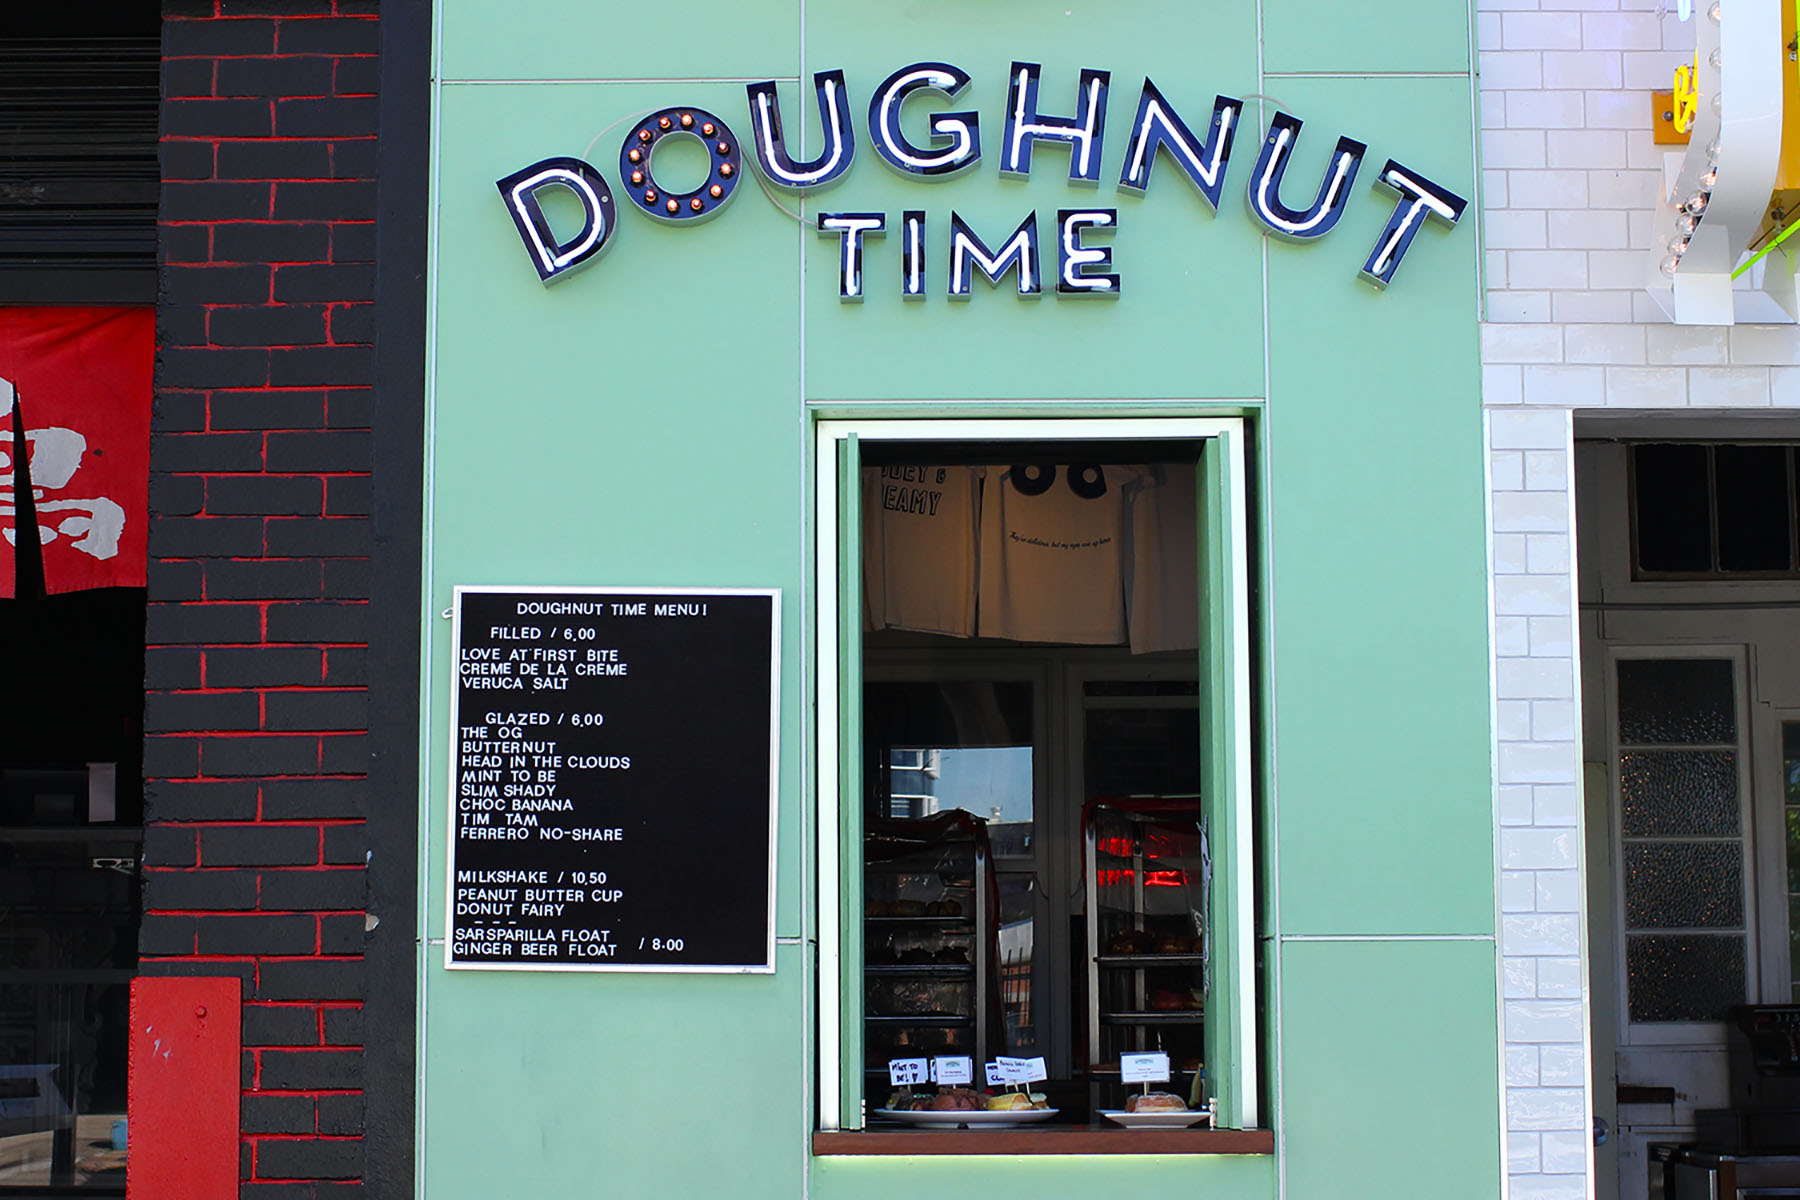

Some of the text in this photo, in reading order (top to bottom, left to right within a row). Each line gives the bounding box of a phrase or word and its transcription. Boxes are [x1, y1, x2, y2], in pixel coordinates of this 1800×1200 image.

[496, 61, 1468, 290] DOUGHNUT
[817, 208, 1120, 303] TIME
[882, 485, 943, 516] EAMY
[516, 602, 604, 616] DOUGHNUT
[610, 603, 647, 616] TIME
[490, 626, 542, 640] FILLED
[550, 627, 557, 639] /
[461, 647, 619, 663] LOVE AT FIRST BITE
[460, 662, 628, 676] CREME DE LA CREME
[462, 676, 569, 690] VERUCA SALT
[485, 711, 550, 726] GLAZED
[557, 712, 565, 725] /
[460, 726, 523, 739] THE OG
[462, 740, 557, 755] BUTTERNUT
[461, 754, 631, 770] HEAD IN THE CLOUDS
[461, 769, 556, 783] MINT TO BE
[460, 783, 557, 798] SLIM SHADY
[459, 798, 574, 812] CHOC BANANA
[460, 812, 539, 827] TIM TAM
[460, 826, 623, 841] FERRERO NO-SHARE
[457, 870, 548, 884] MILKSHAKE
[557, 871, 565, 884] /
[458, 887, 623, 903] PEANUT BUTTER CUP
[456, 902, 565, 917] DONUT FAIRY
[455, 927, 611, 943] SARSPARILLA FLOAT
[453, 941, 617, 957] GINGER BEER FLOAT
[638, 937, 684, 952] / 8.00
